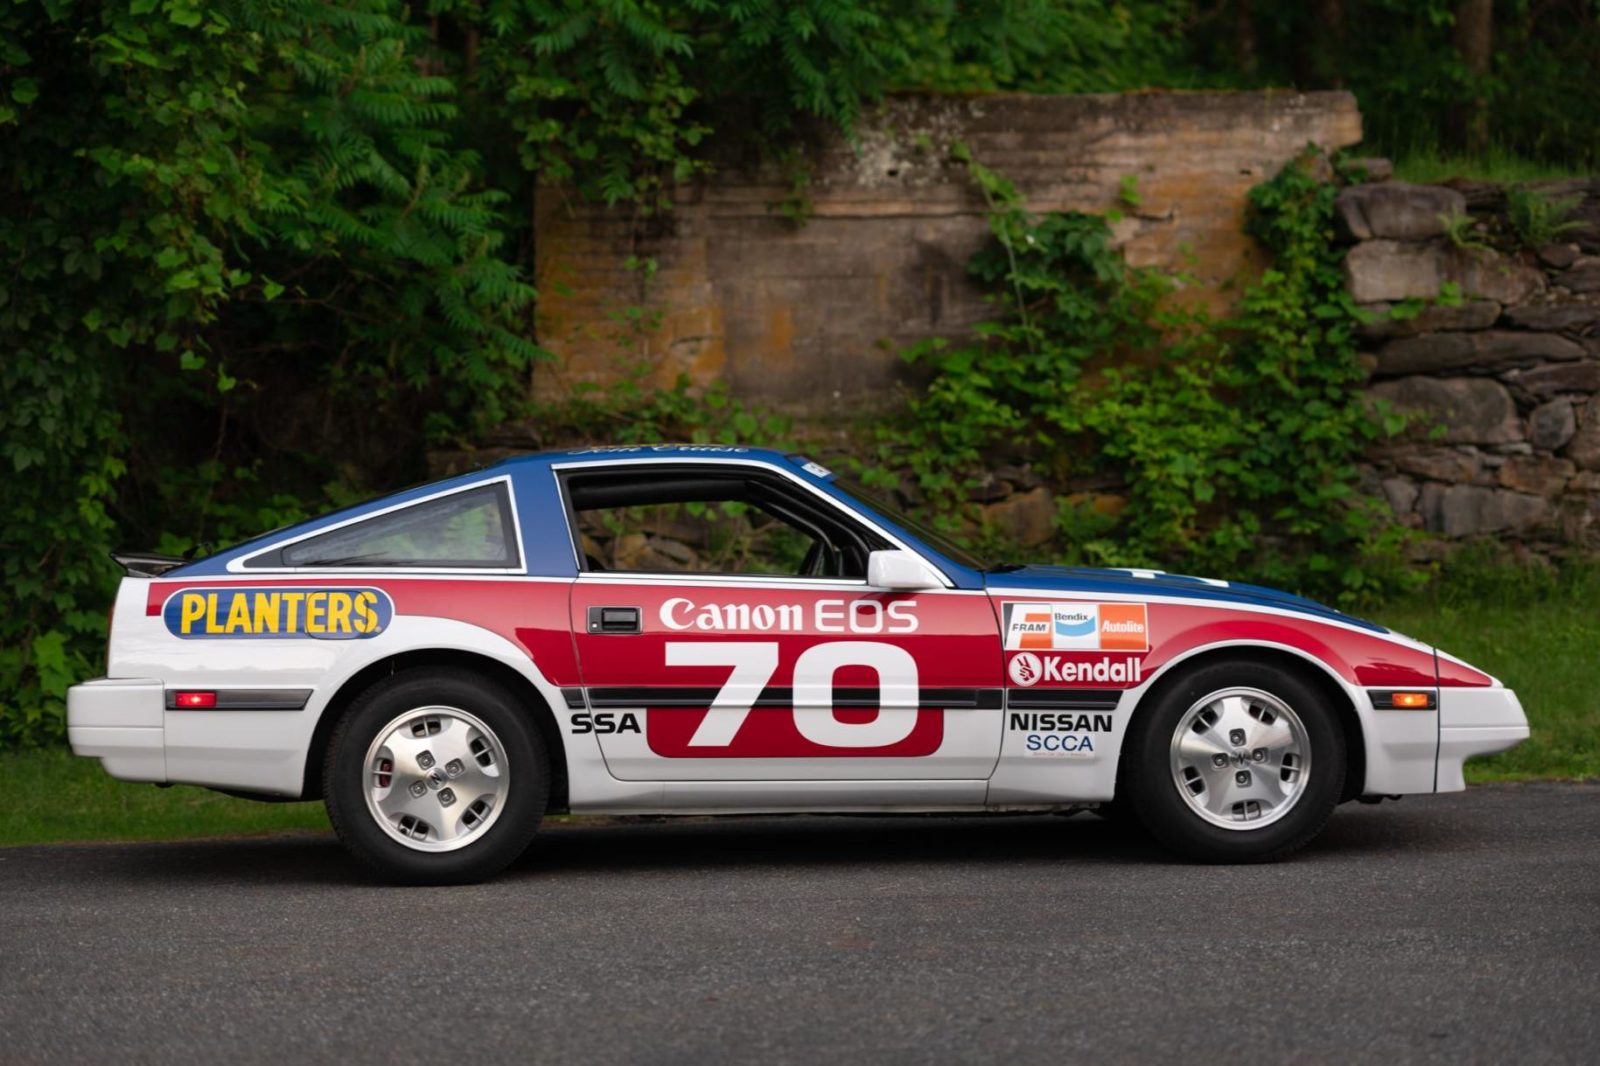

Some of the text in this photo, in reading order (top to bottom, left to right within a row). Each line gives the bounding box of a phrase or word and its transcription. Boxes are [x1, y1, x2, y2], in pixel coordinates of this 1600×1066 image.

[181, 591, 378, 634] PLANTERS
[659, 598, 919, 633] Canon EOS
[1054, 612, 1088, 621] Bendix
[1012, 623, 1046, 632] FRAM
[1102, 620, 1144, 633] Autolite
[1044, 656, 1141, 682] Kendall
[665, 641, 920, 748] 70
[571, 713, 642, 734] SSA
[1010, 713, 1112, 732] NISSAN
[1026, 734, 1093, 752] SCCA
